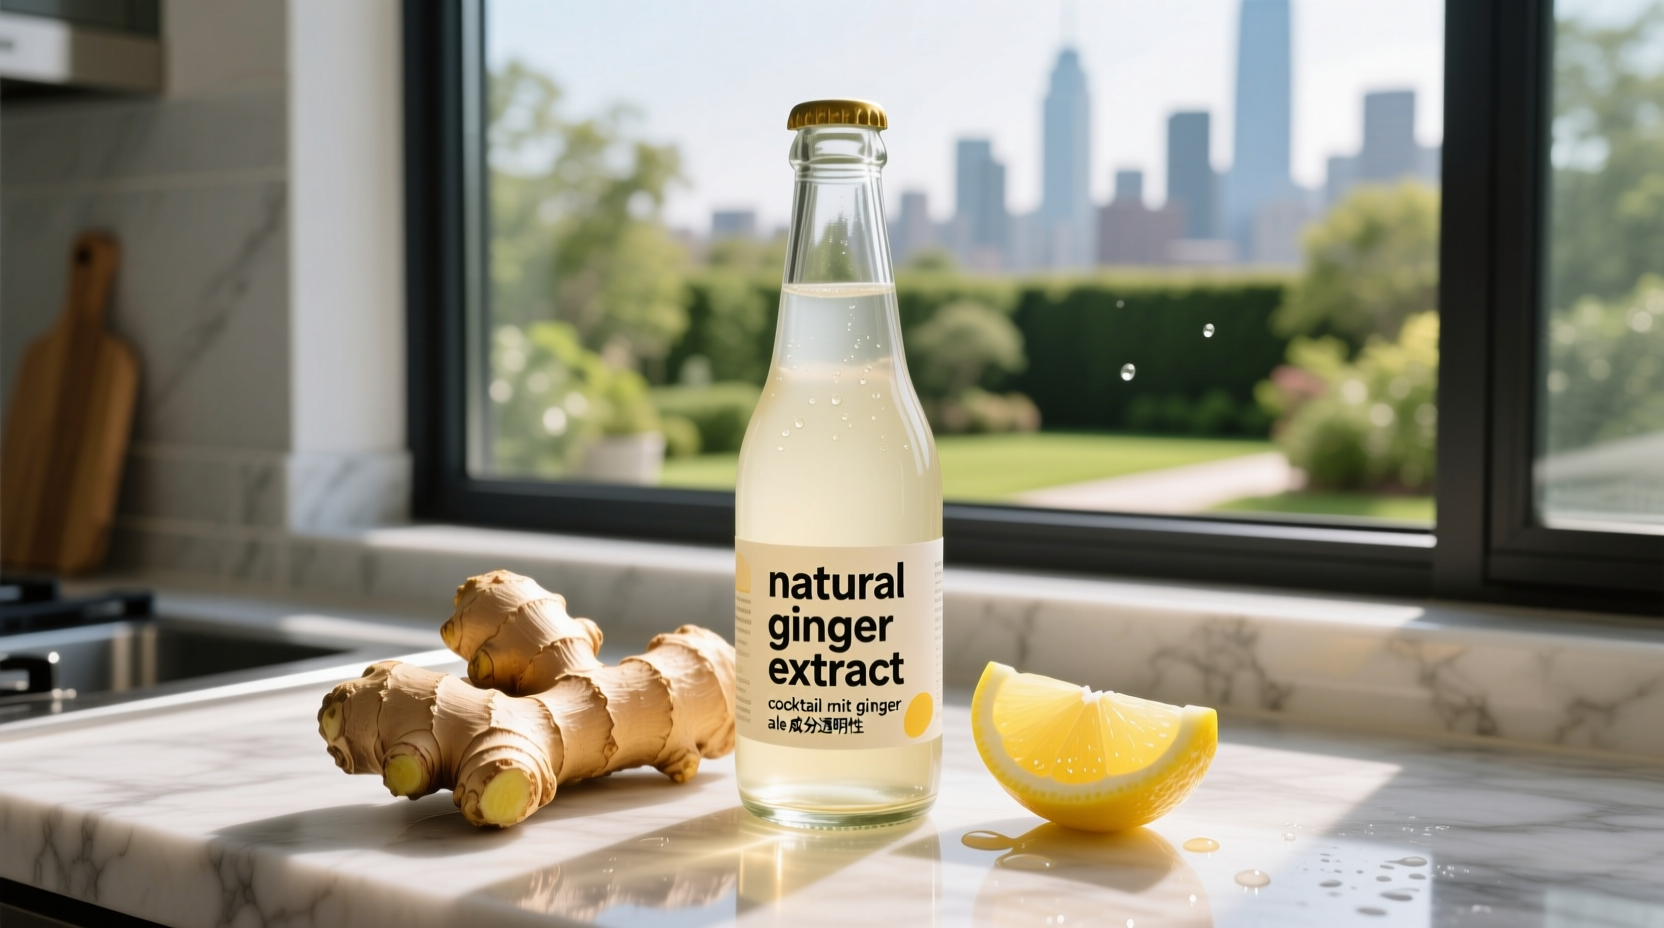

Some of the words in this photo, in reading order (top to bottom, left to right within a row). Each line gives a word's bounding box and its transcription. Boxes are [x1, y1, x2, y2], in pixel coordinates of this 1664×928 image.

[769, 561, 905, 601] natural
[768, 605, 894, 654] ginger
[768, 651, 905, 688] extract
[767, 714, 787, 731] ale
[768, 697, 822, 713] cocktail
[827, 698, 852, 713] mit
[856, 699, 902, 717] ginger
